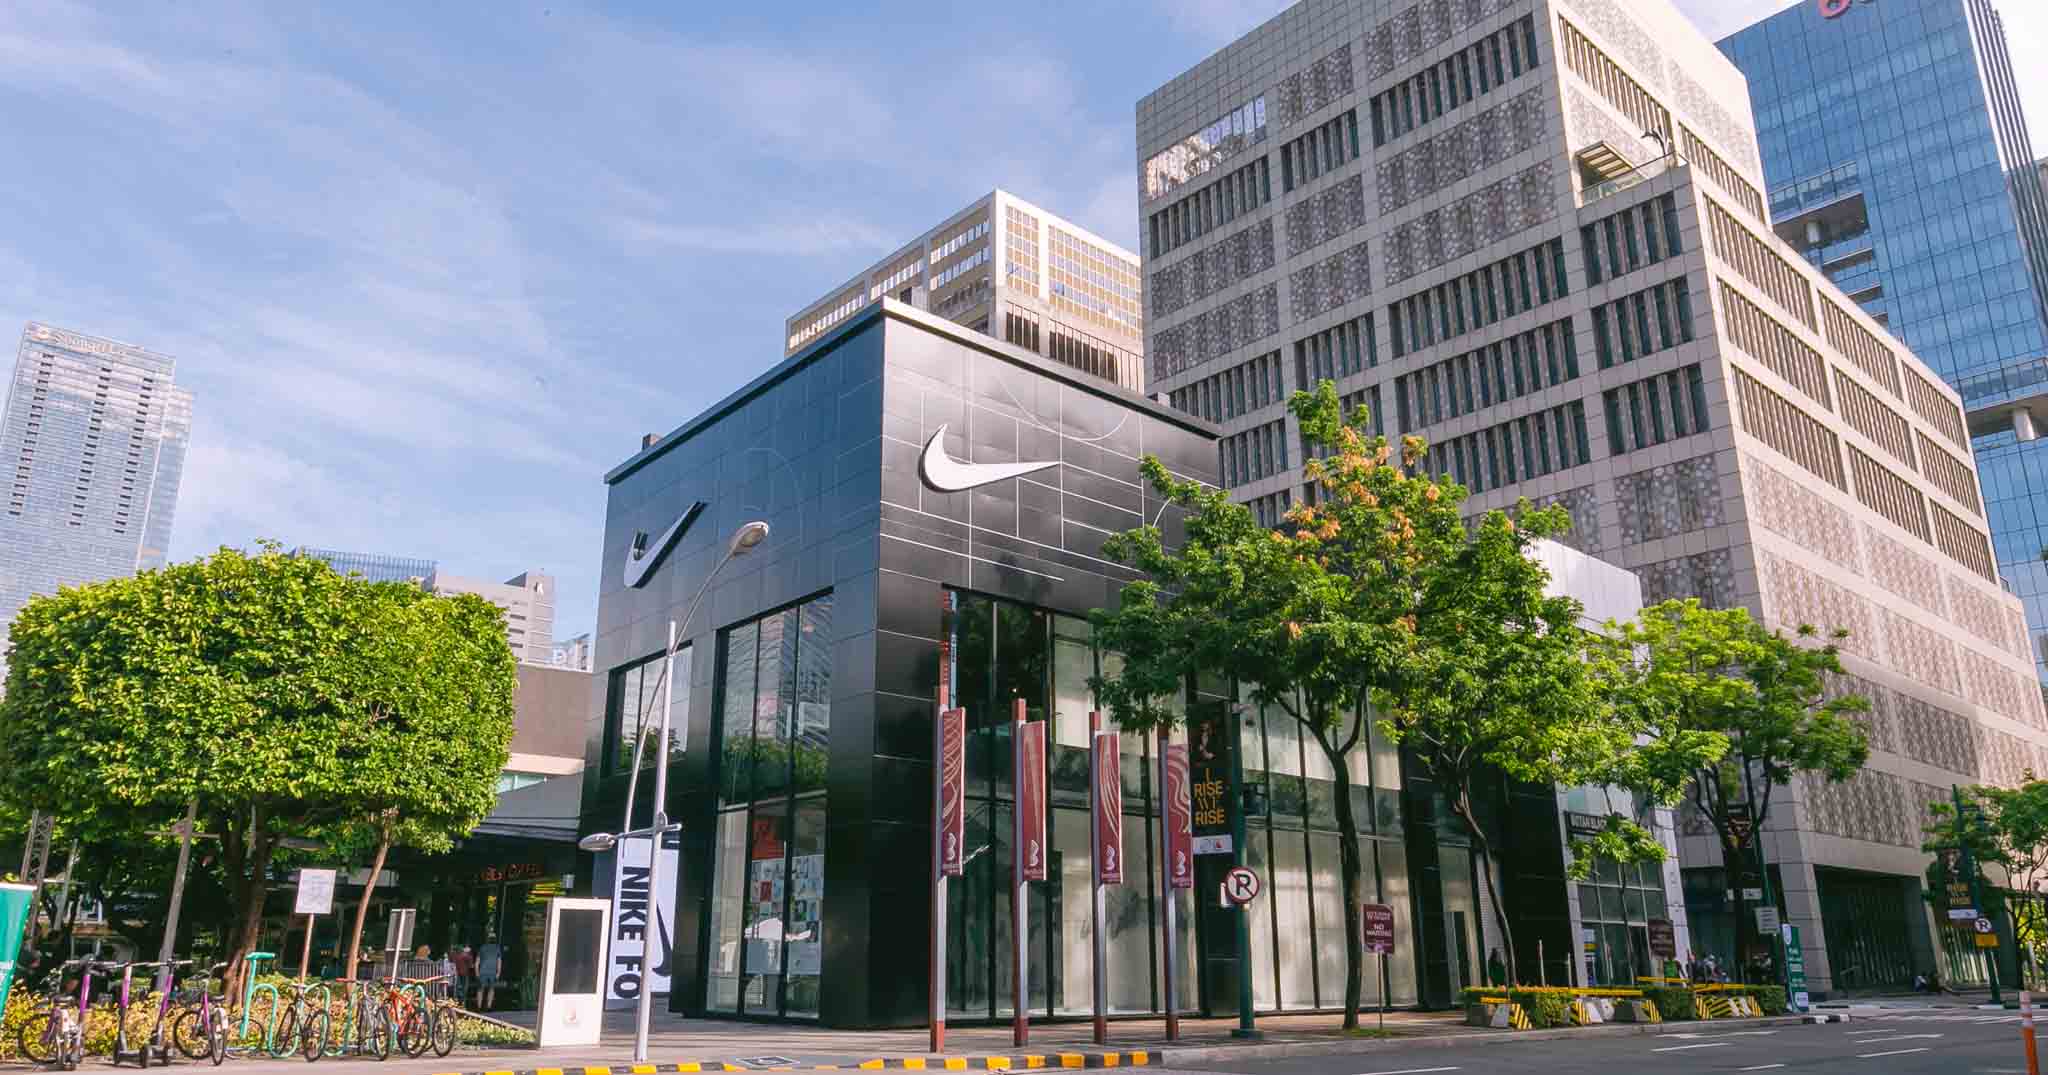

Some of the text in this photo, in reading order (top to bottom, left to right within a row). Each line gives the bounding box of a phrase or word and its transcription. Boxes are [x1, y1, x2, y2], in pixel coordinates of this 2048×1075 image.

[1194, 782, 1224, 797] RISE
[1195, 810, 1225, 825] RISE
[613, 867, 650, 999] NIKE FO
